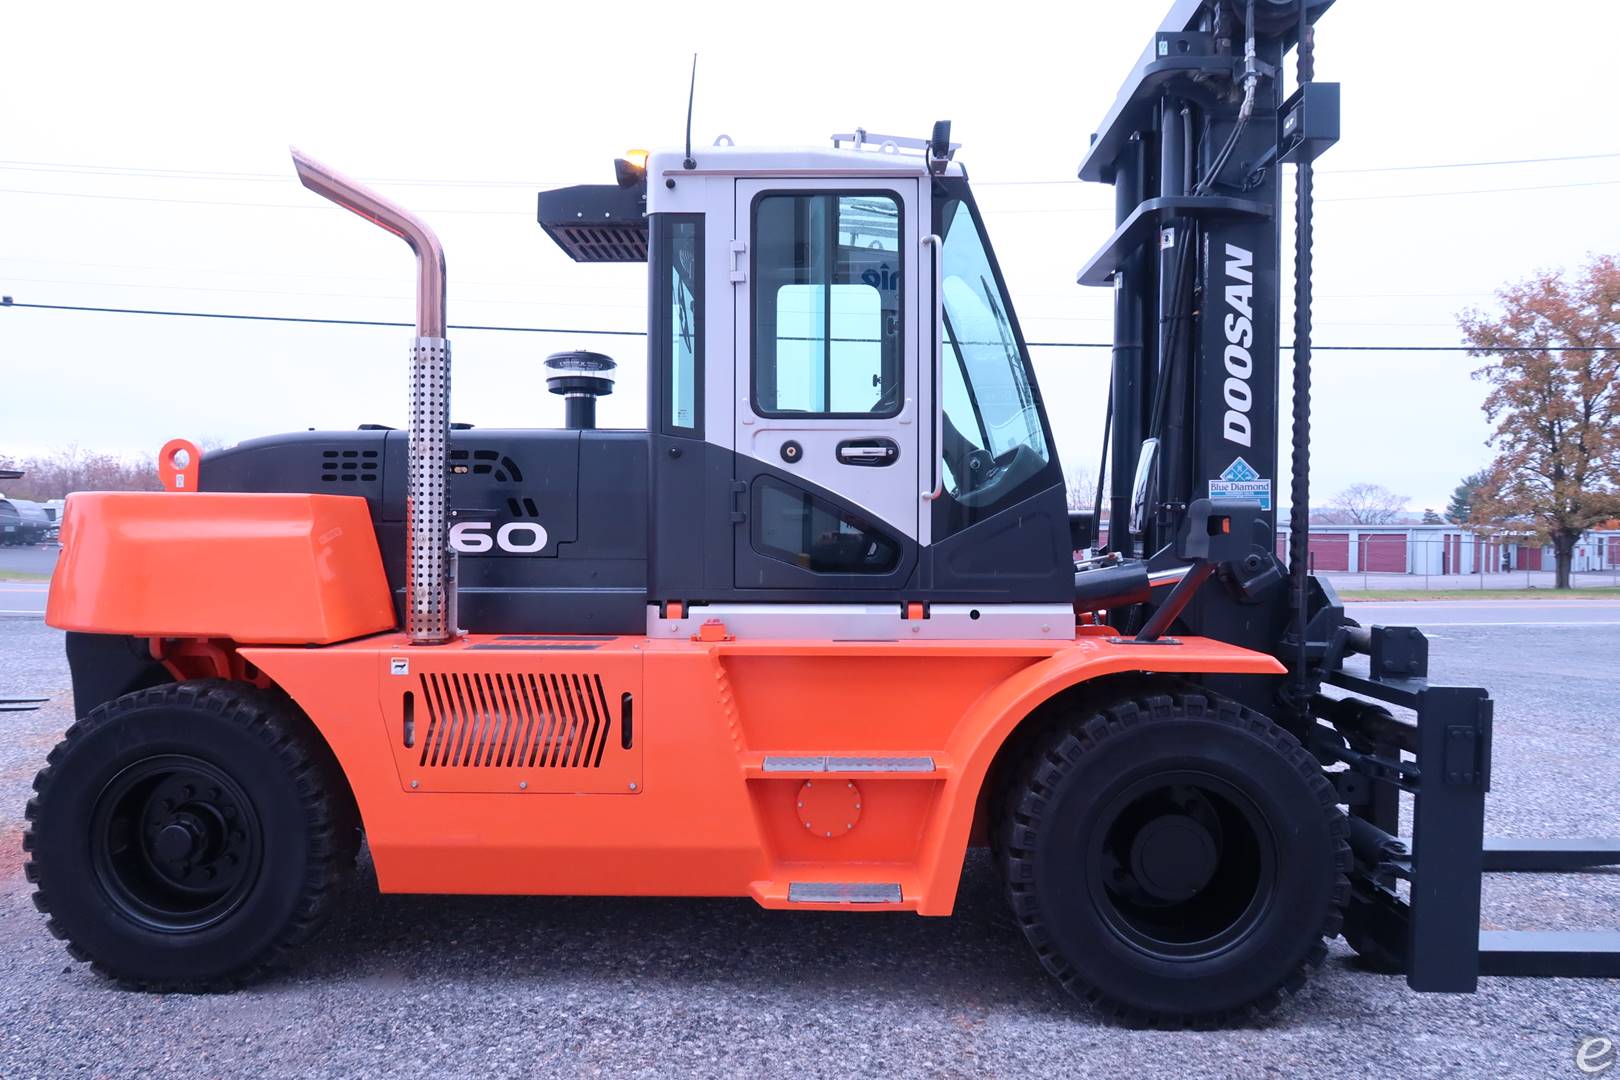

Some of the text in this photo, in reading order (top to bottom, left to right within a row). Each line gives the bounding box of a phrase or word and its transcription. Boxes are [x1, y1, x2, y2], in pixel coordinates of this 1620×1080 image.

[1223, 242, 1253, 448] DOOSAN
[1210, 482, 1269, 491] Blue Diamond
